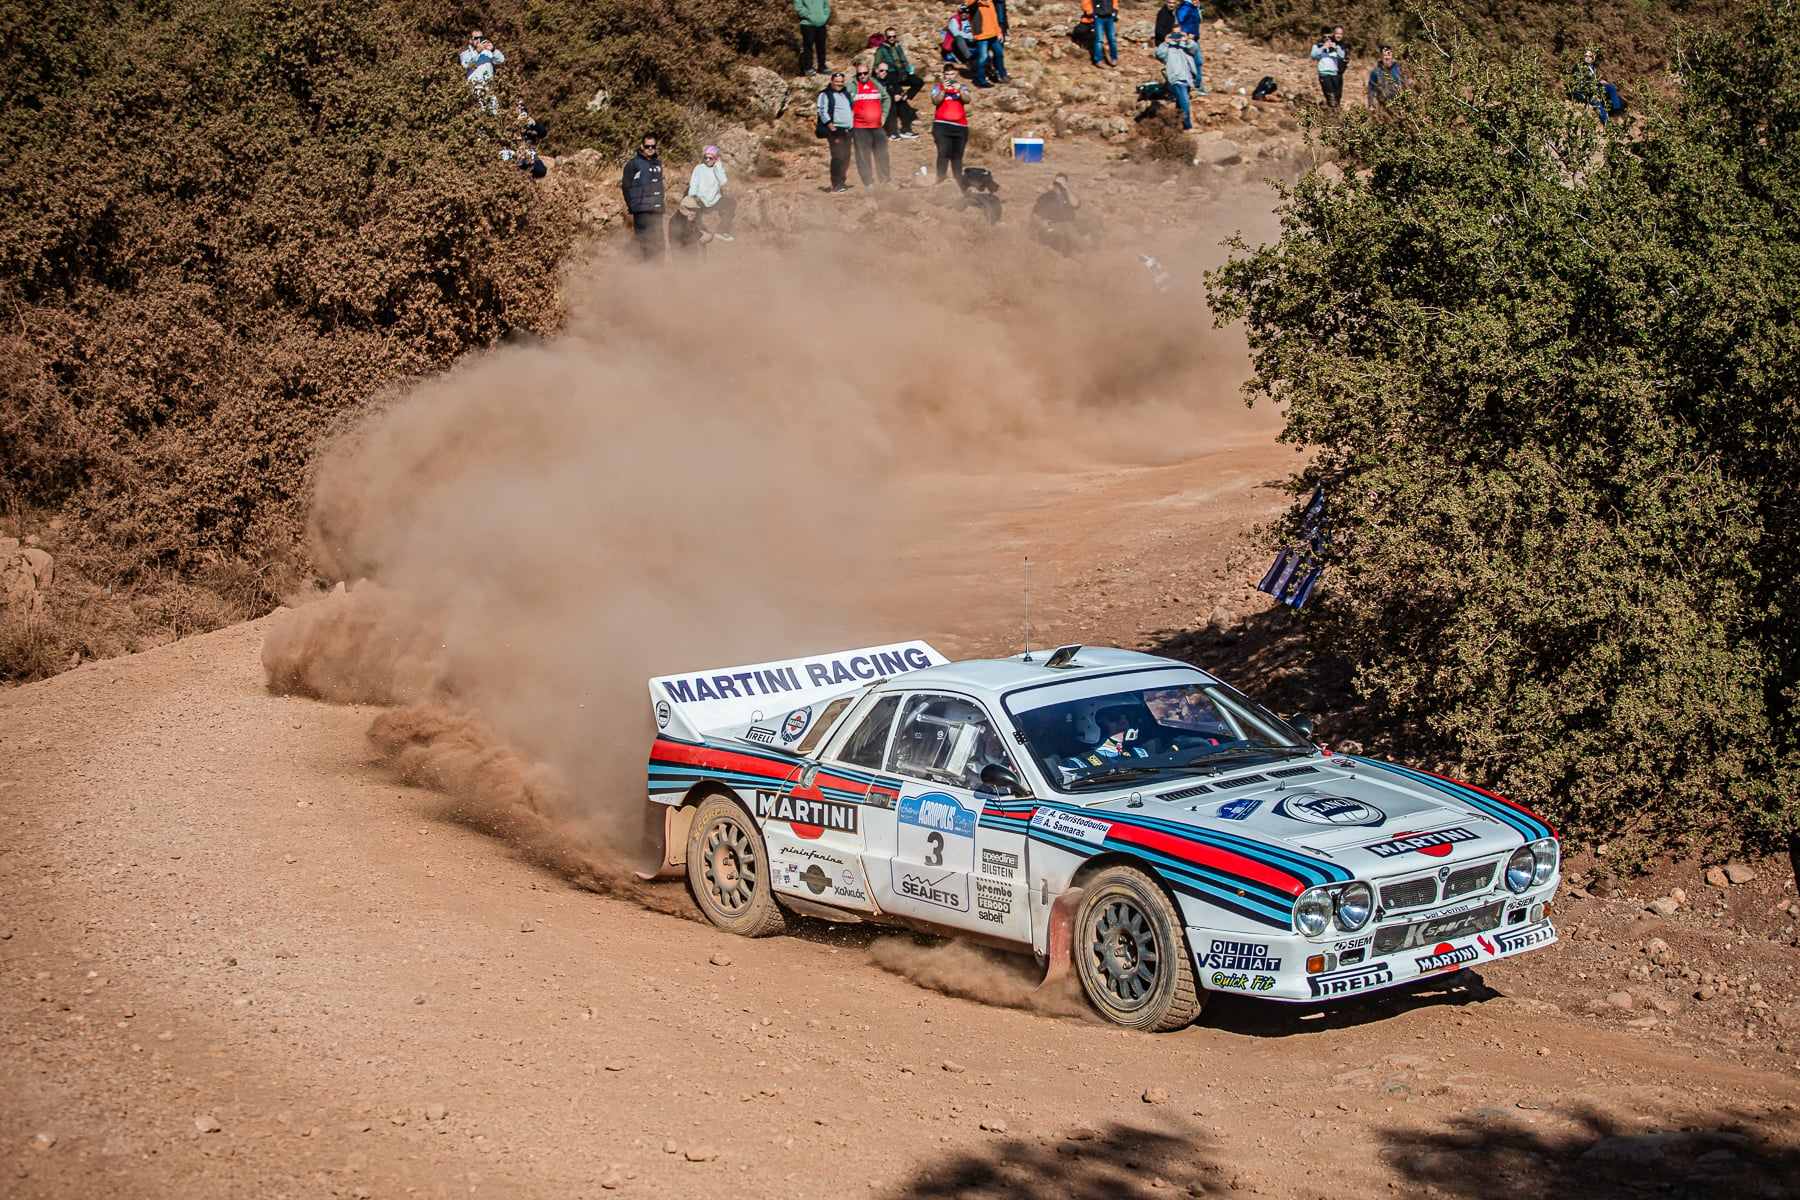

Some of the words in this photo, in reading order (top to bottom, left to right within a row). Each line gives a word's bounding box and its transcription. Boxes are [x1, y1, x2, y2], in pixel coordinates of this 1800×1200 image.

[662, 666, 802, 704] MARTINI
[805, 648, 933, 687] RACING
[745, 726, 777, 744] PIRELLI
[759, 793, 854, 830] MARTINI
[918, 800, 957, 831] ACROPOLIS
[1048, 810, 1056, 818] A.
[1058, 813, 1108, 832] Christodoulou
[1042, 818, 1051, 828] A.
[1052, 821, 1085, 837] Samaras
[923, 831, 945, 866] 3
[1373, 829, 1472, 857] MARTINI
[780, 846, 844, 865] pininfarina
[983, 851, 1015, 865] speedline
[982, 863, 1014, 879] BILSTEIN
[901, 881, 960, 907] SEAJETS
[976, 881, 1012, 898] brembo
[979, 899, 1009, 912] FERODO
[1517, 896, 1536, 908] SIEM
[1347, 936, 1373, 949] SIEM
[1493, 917, 1554, 953] PIRELLI
[1212, 940, 1268, 957] OLIO
[1222, 955, 1281, 971] FIAT
[1418, 947, 1478, 972] MARTINI
[1211, 971, 1249, 990] Quick
[1250, 974, 1276, 991] Fit
[1307, 962, 1393, 997] PIRELLI
